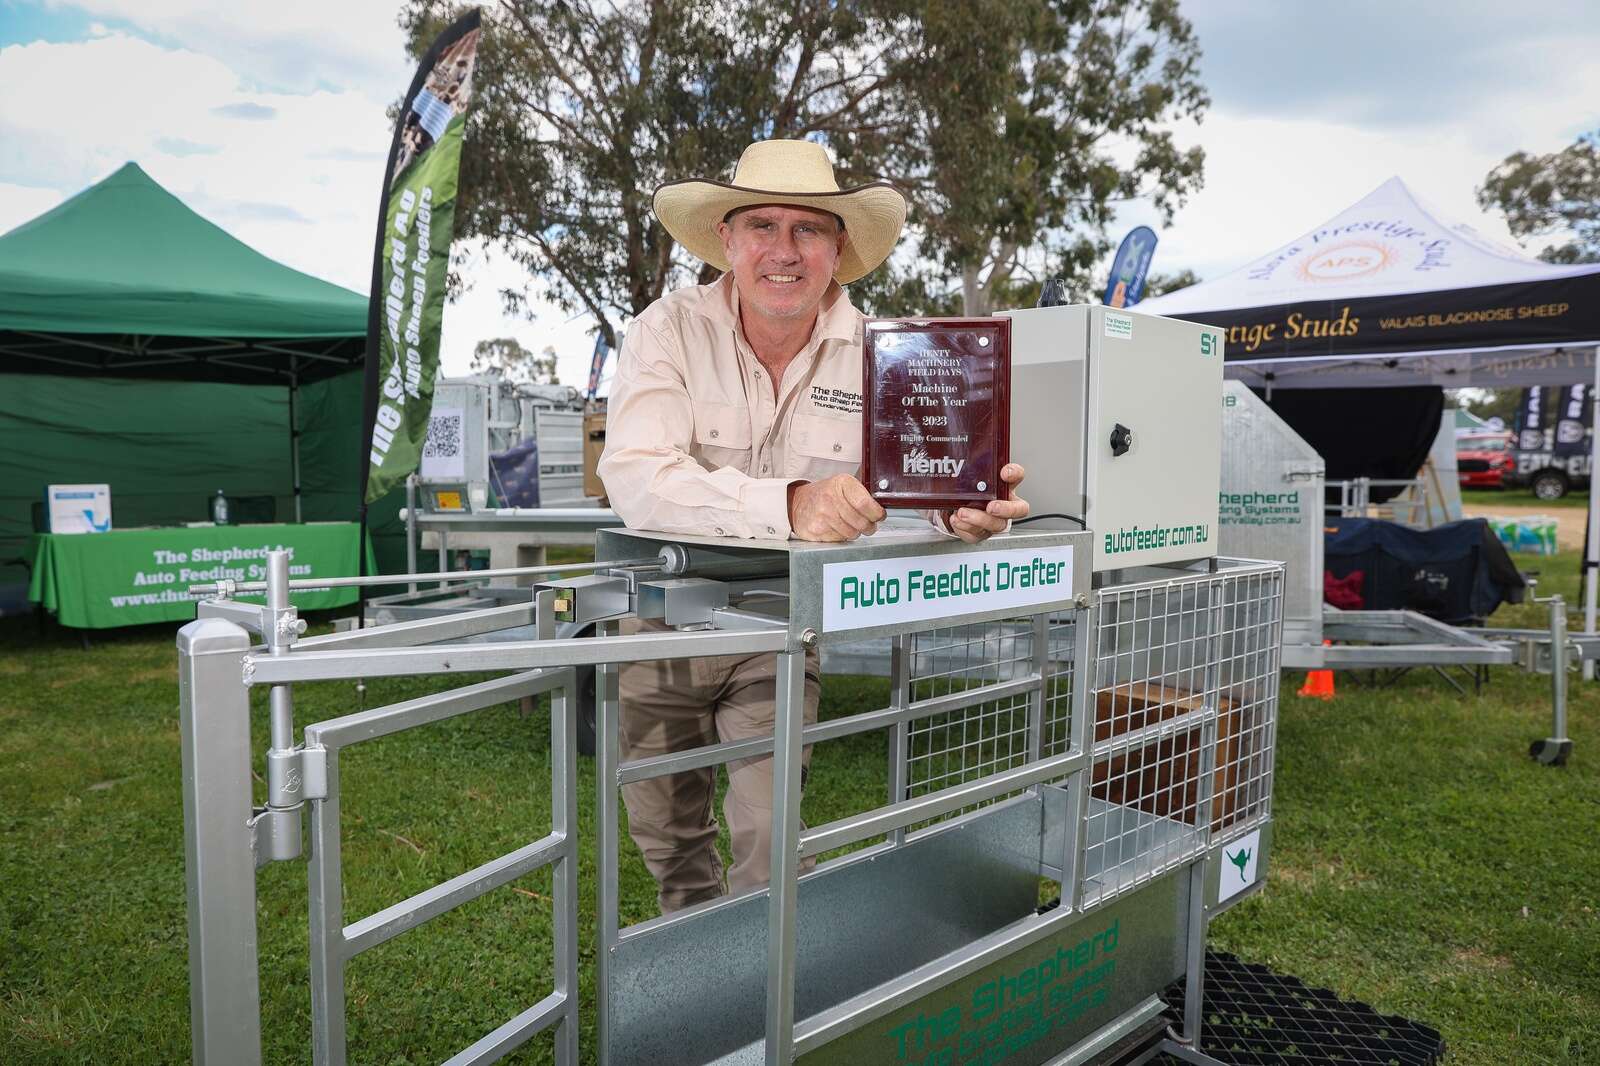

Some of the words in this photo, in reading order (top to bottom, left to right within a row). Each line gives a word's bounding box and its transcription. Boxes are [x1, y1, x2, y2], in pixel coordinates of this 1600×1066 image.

[411, 186, 433, 275] Feeders
[1284, 306, 1360, 339] Studs
[1378, 315, 1426, 330] VALAIS
[1428, 307, 1515, 328] BLACKNOSE
[1517, 302, 1569, 320] SHEEP
[1201, 333, 1217, 356] S1
[907, 359, 962, 367] MACHINERY
[908, 368, 937, 377] FIELD
[938, 368, 962, 377] DAYS
[812, 386, 830, 396] The
[912, 383, 958, 394] Machine
[811, 393, 828, 402] Auto
[829, 396, 851, 407] Sheep
[901, 396, 915, 407] Of
[917, 396, 939, 407] The
[942, 396, 968, 407] Year
[922, 416, 948, 426] 2023
[900, 434, 925, 443] Highly
[926, 434, 969, 443] Commended
[903, 453, 965, 478] henty
[1246, 505, 1300, 516] Systems
[1105, 523, 1209, 554] autofeeder.com.au
[153, 550, 187, 565] The
[191, 545, 269, 565] Shepherd
[134, 571, 176, 586] Auto
[179, 565, 245, 582] Feeding
[248, 564, 312, 580] Syms
[840, 572, 900, 610] Auto
[908, 565, 990, 602] Feedlot
[997, 558, 1066, 589] Drafter
[887, 1005, 961, 1060] The
[972, 917, 1120, 1022] Shepherd
